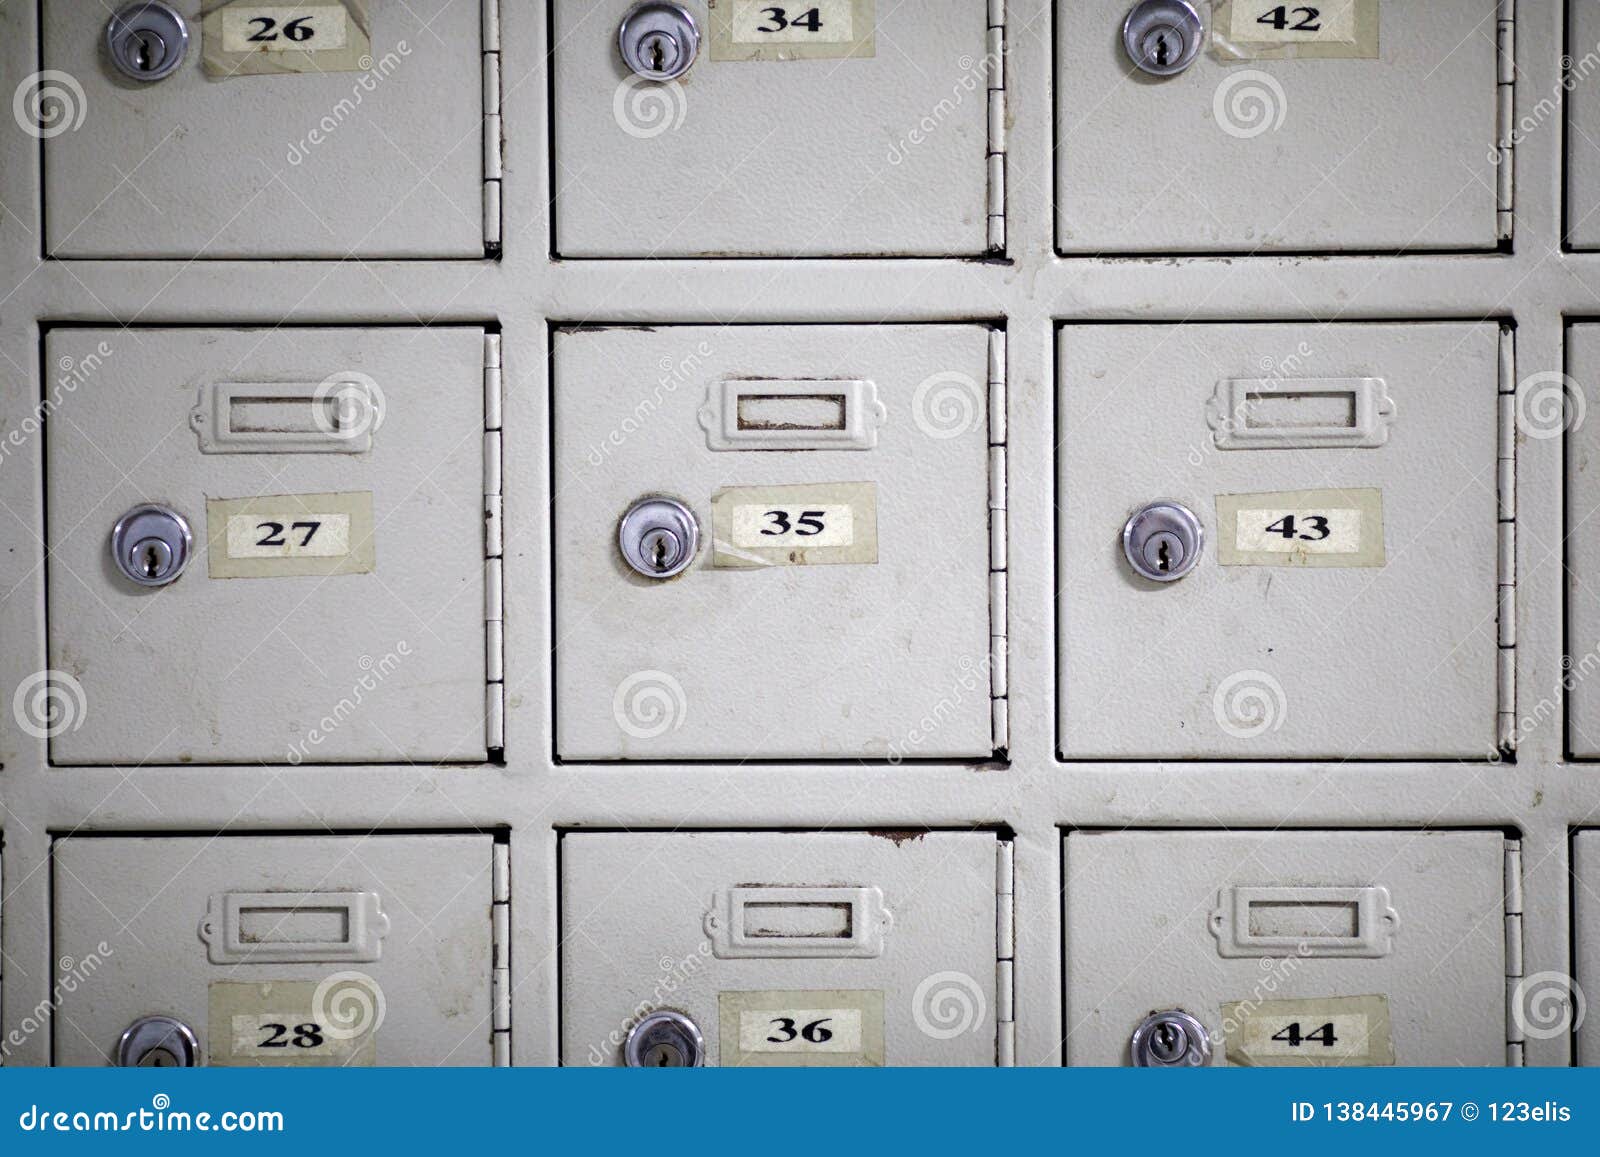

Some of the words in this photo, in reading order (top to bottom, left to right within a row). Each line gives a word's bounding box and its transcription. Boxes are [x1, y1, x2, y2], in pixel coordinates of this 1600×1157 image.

[248, 15, 316, 42] 26
[757, 6, 824, 33] 34
[1256, 5, 1322, 32] 42
[255, 521, 321, 547] 27
[760, 510, 826, 536] 35
[1265, 514, 1330, 541] 43
[256, 1022, 324, 1049] 28
[766, 1017, 833, 1043] 36
[1271, 1022, 1339, 1047] 44
